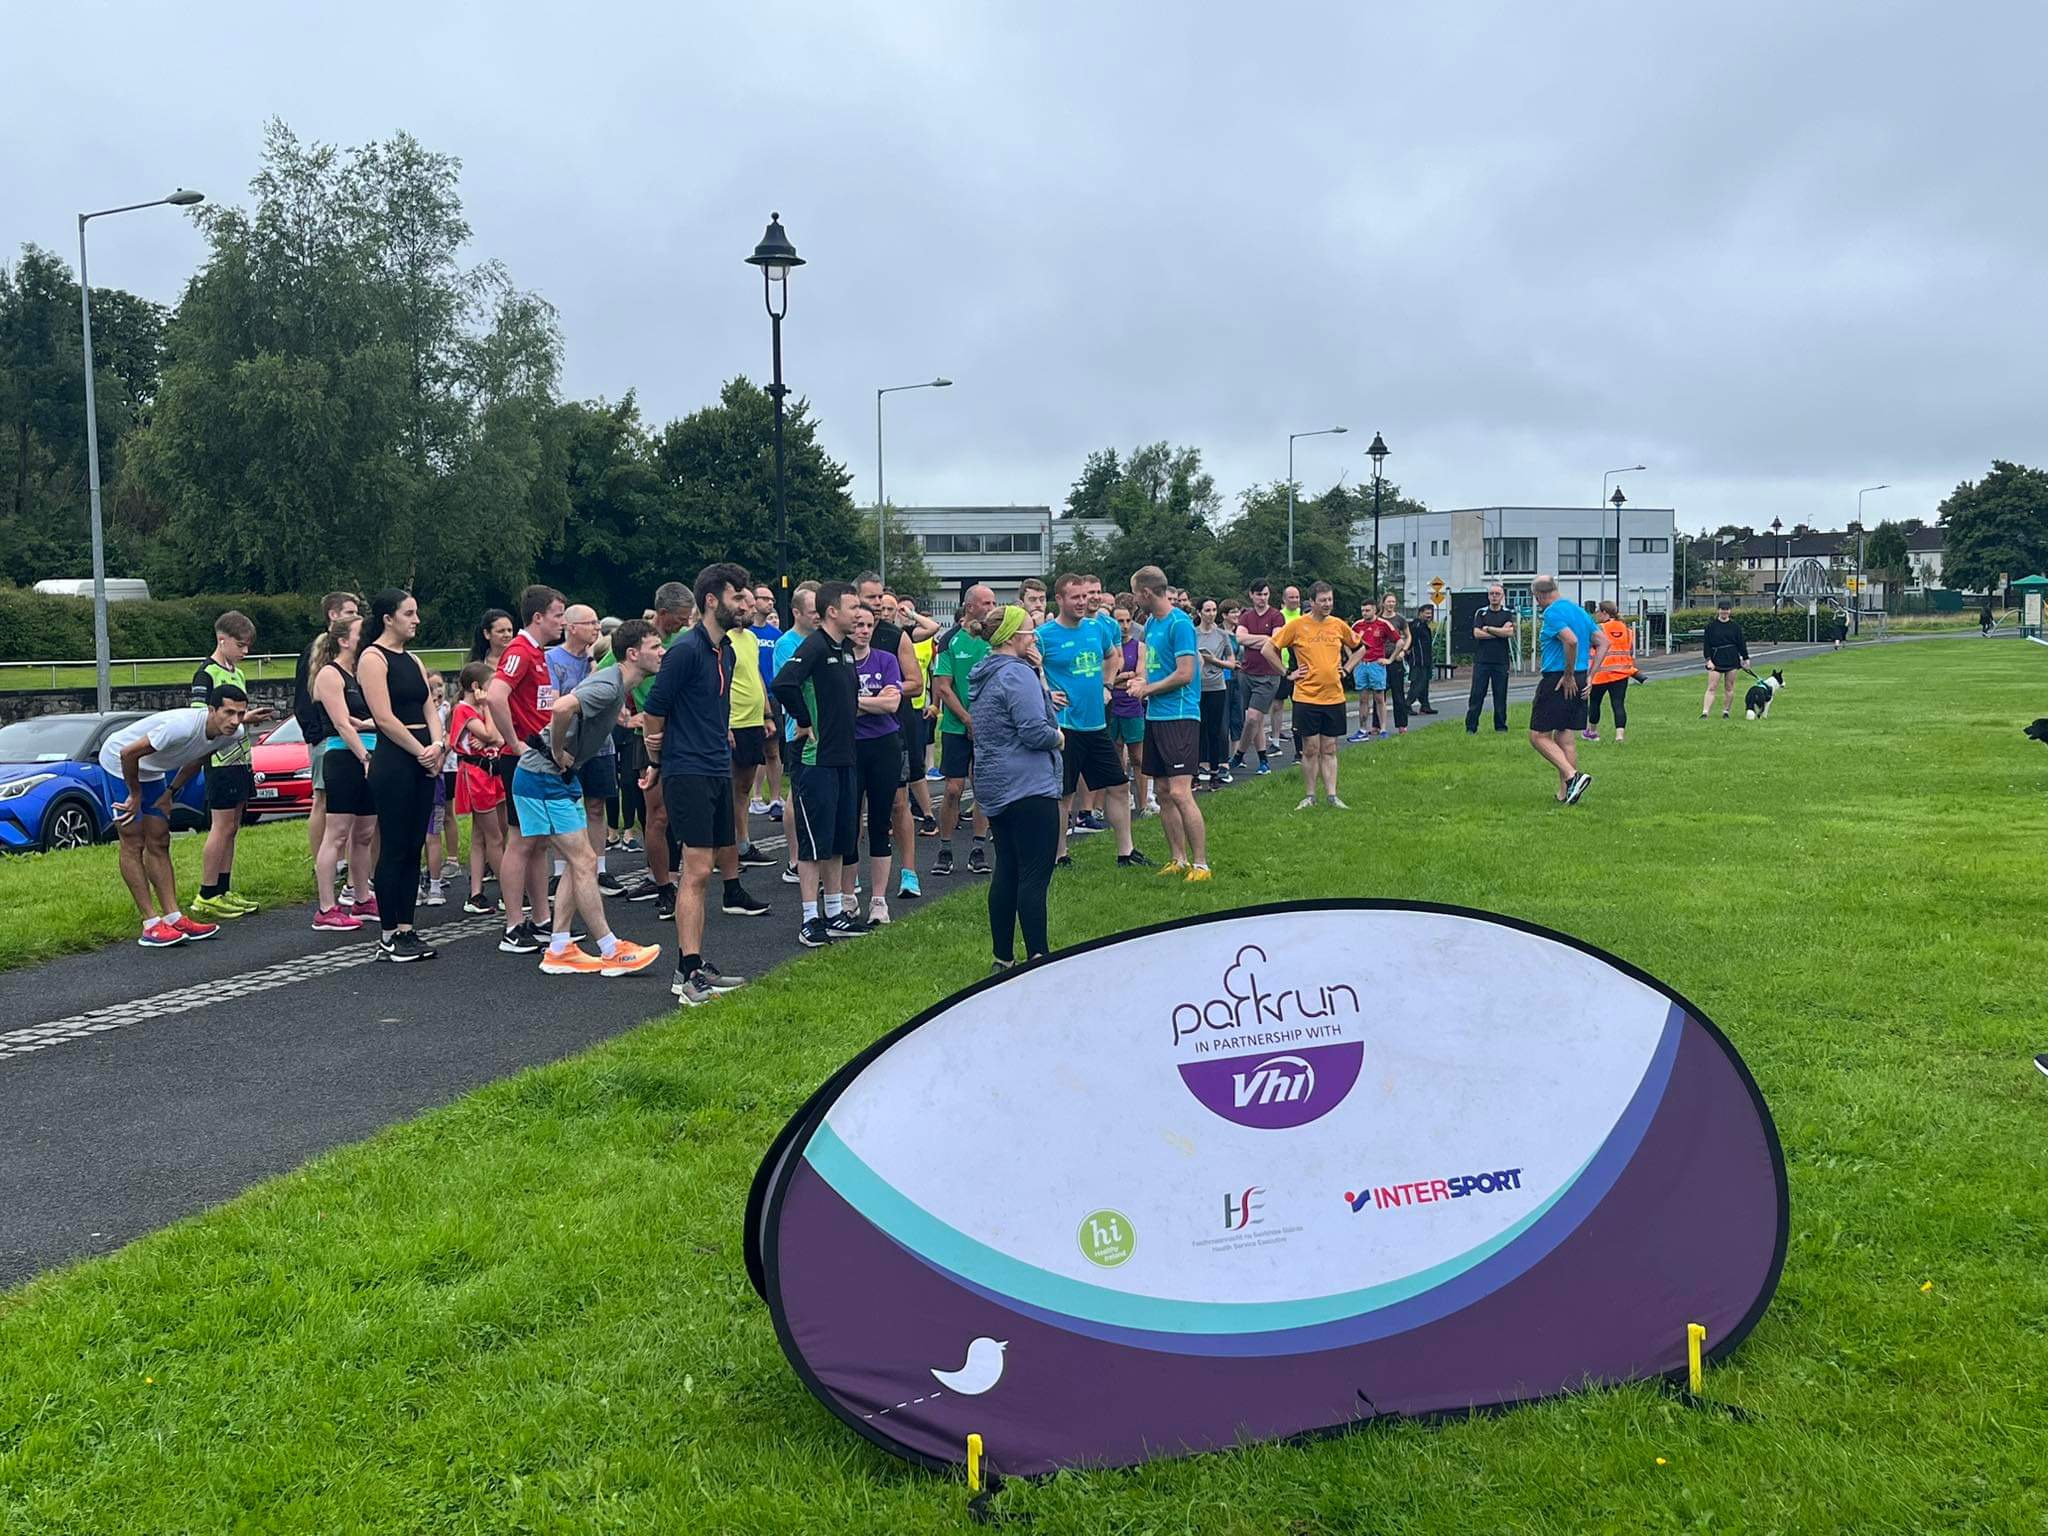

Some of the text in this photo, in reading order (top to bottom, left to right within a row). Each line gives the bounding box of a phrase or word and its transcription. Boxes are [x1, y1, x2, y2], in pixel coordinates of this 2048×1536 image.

[1172, 944, 1360, 1046] parkrun
[1195, 1024, 1342, 1053] IN PARTNERSHIP WITH
[1232, 1066, 1308, 1108] Vhi
[1224, 1186, 1266, 1231] HSE
[1373, 1168, 1521, 1210] INTERSPORT
[1090, 1218, 1122, 1247] hi
